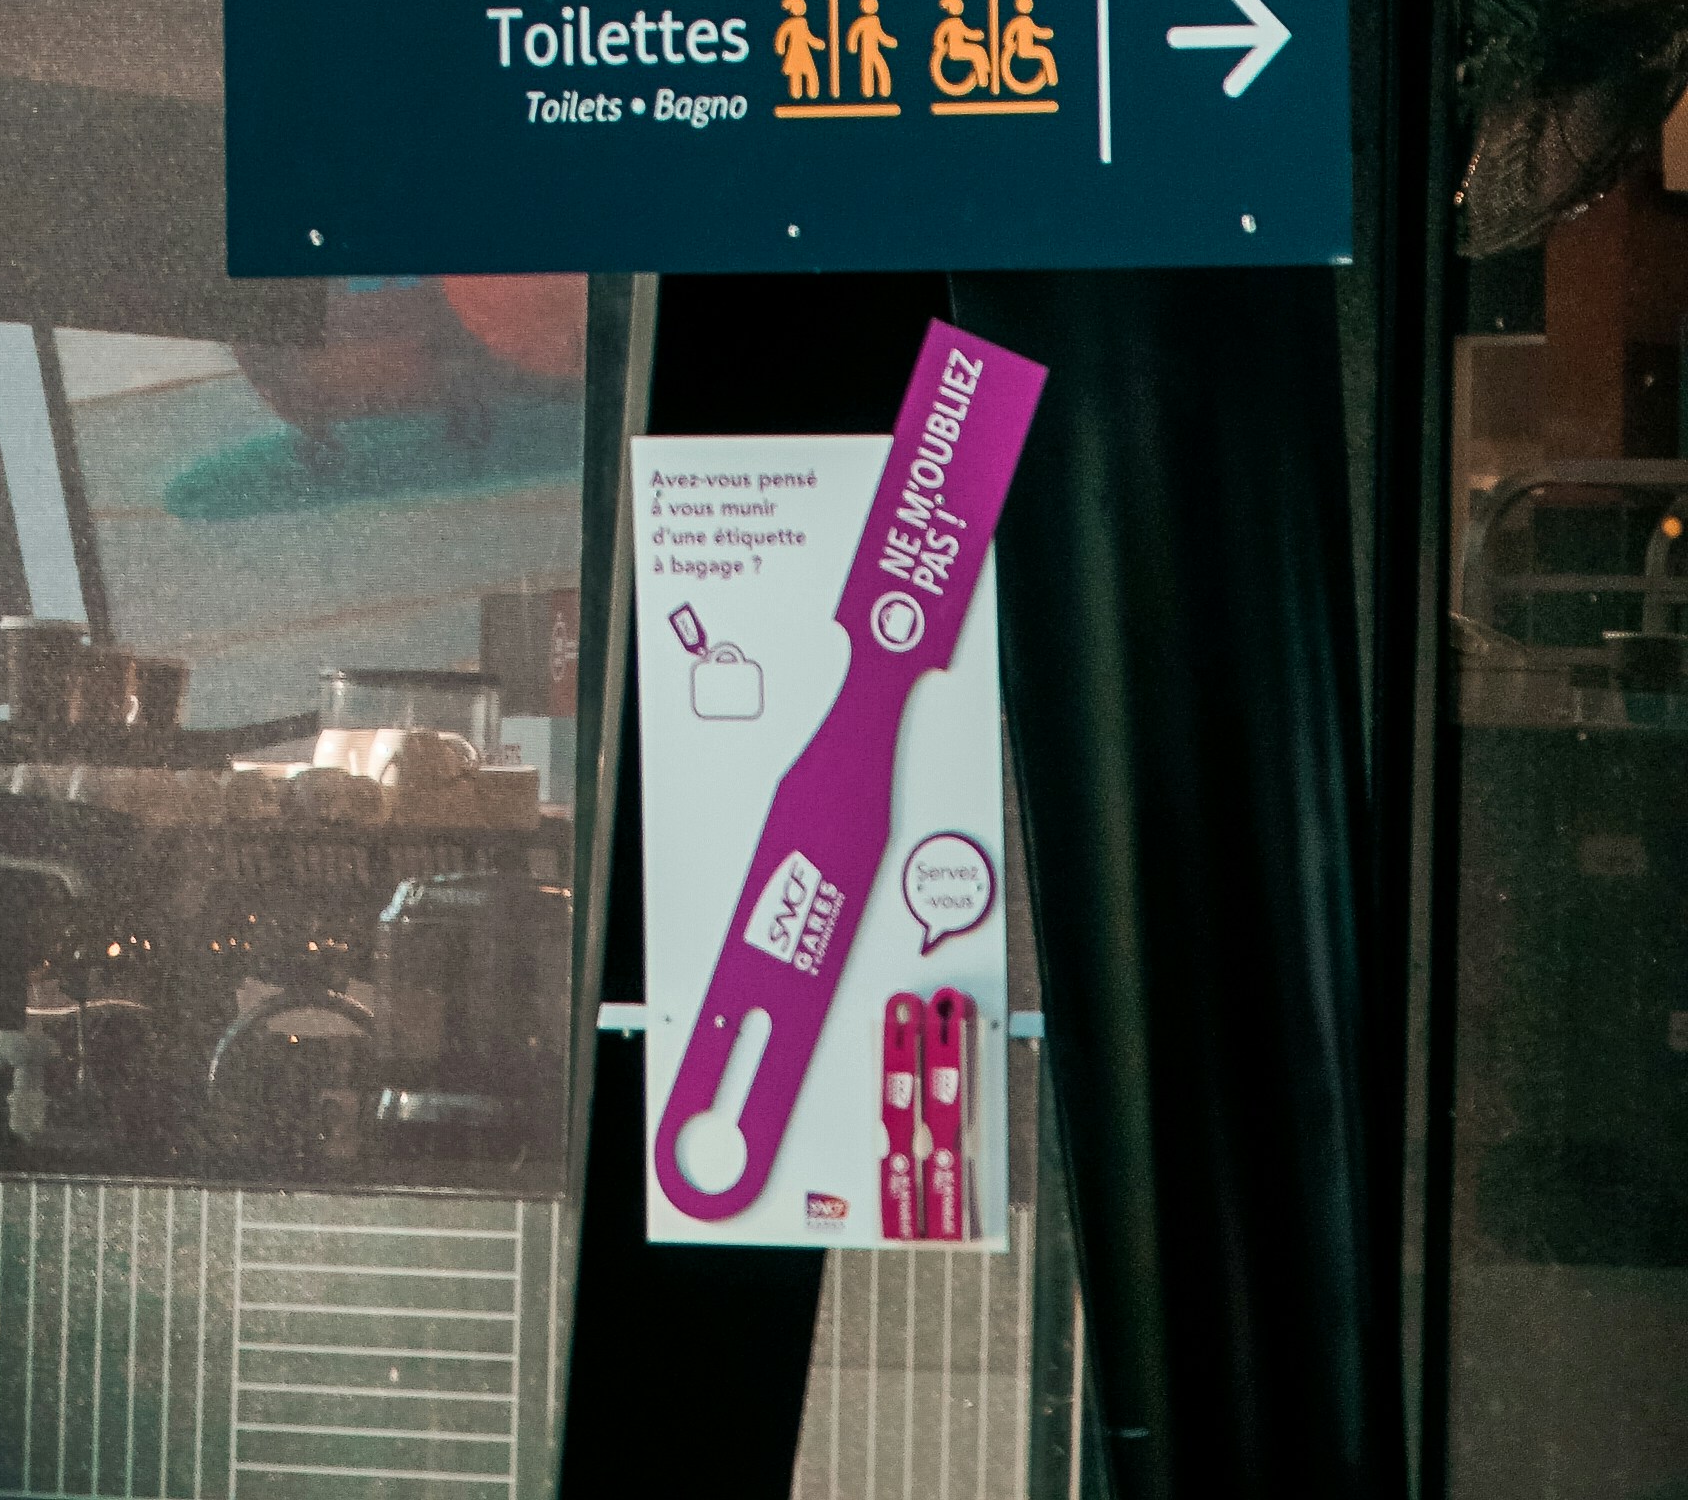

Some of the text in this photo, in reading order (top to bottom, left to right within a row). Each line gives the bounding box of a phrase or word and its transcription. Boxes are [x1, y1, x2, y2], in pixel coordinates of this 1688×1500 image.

[486, 5, 750, 67] Toilettes
[526, 88, 748, 129] Toilets Bagno
[878, 348, 984, 580] NE M'OUBLIEZ
[651, 469, 818, 491] Avez-vous pensé
[669, 503, 714, 517] vous
[721, 499, 778, 516] munir
[652, 527, 807, 550] d'une étiquette
[670, 555, 744, 580] bagage
[912, 527, 960, 595] PAS
[916, 862, 979, 881] Servez
